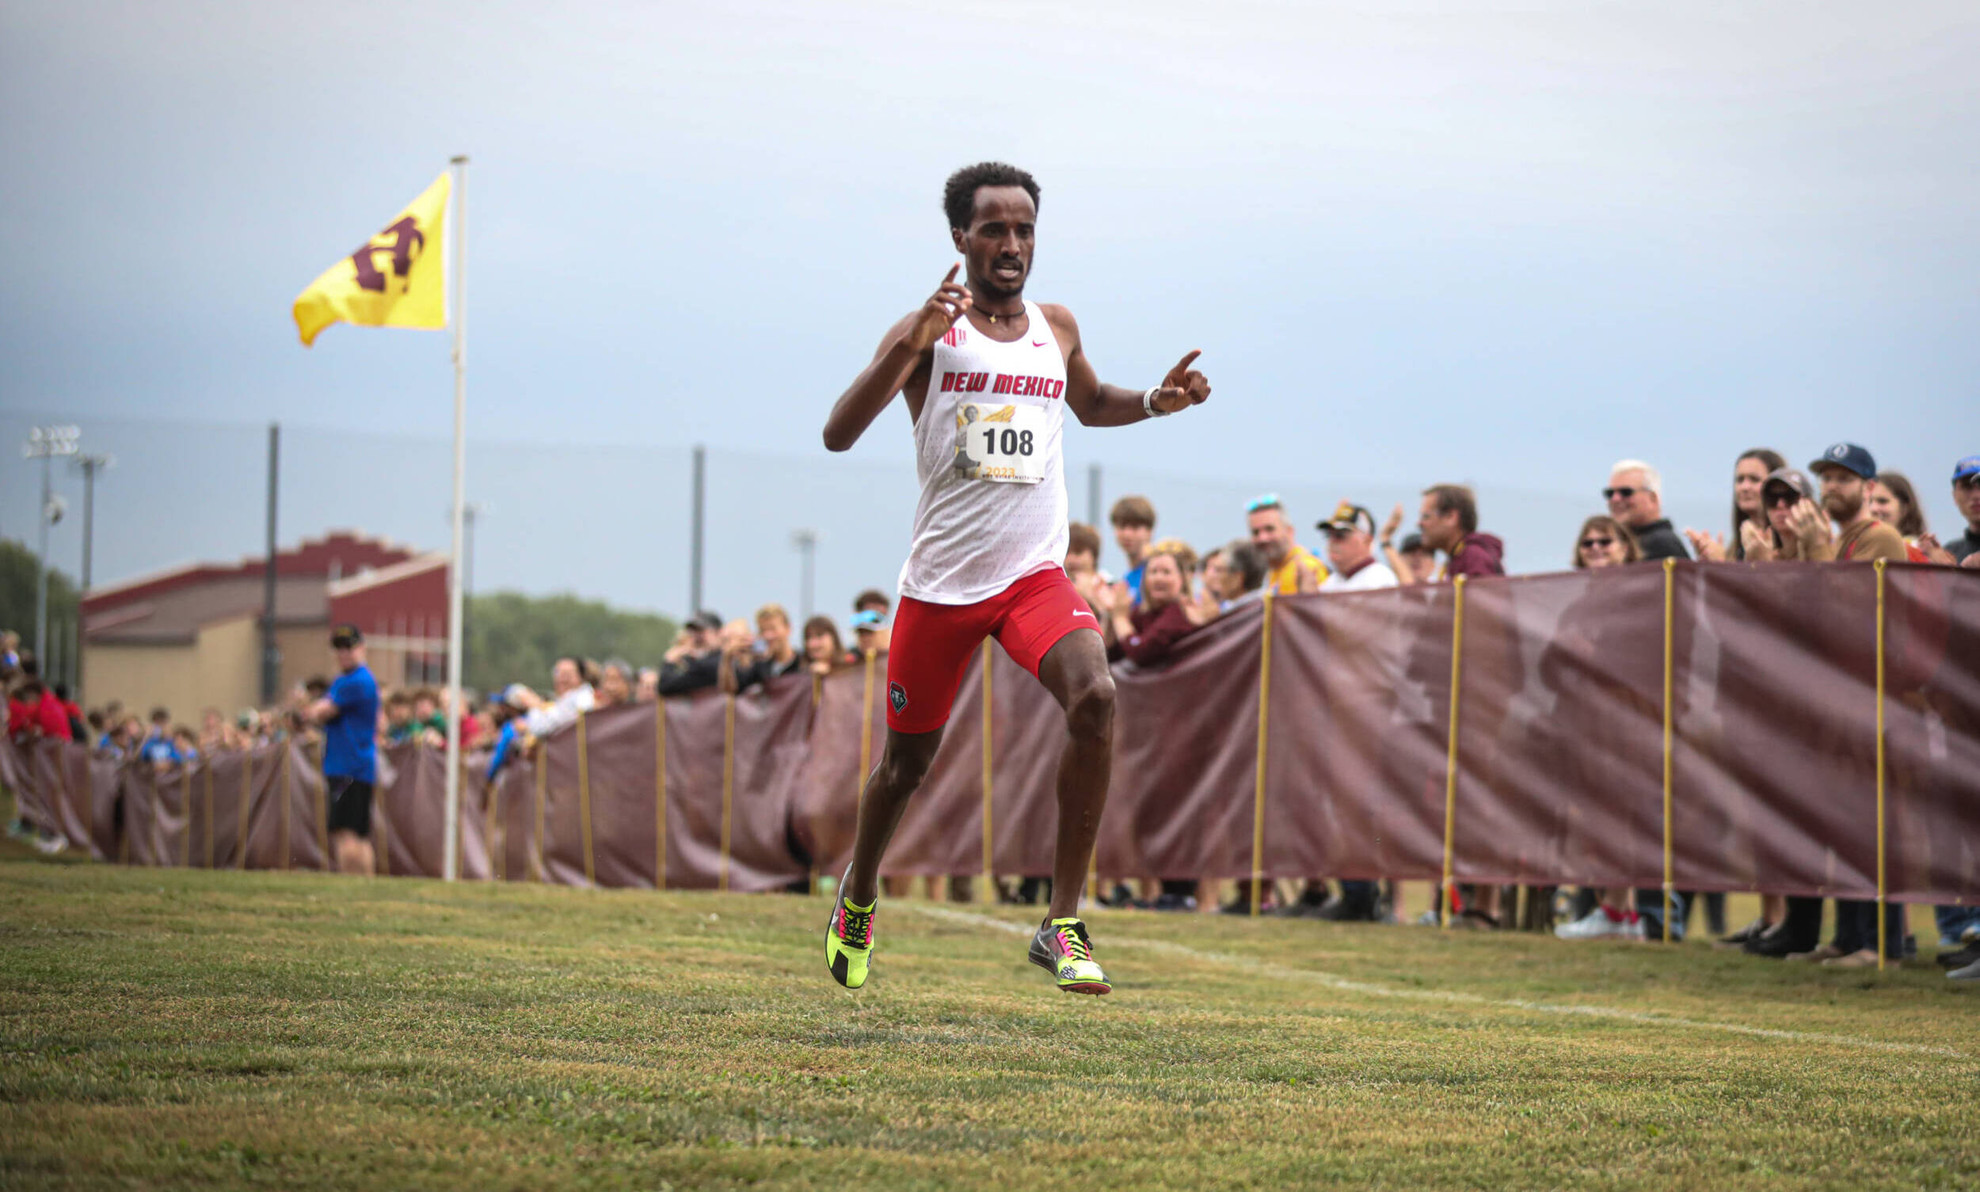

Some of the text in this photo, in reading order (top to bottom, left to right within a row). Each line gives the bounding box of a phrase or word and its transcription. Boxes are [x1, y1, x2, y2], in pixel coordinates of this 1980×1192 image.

[940, 371, 1064, 399] NEW MEXICO
[982, 427, 1034, 456] 108
[985, 466, 1016, 479] 2023
